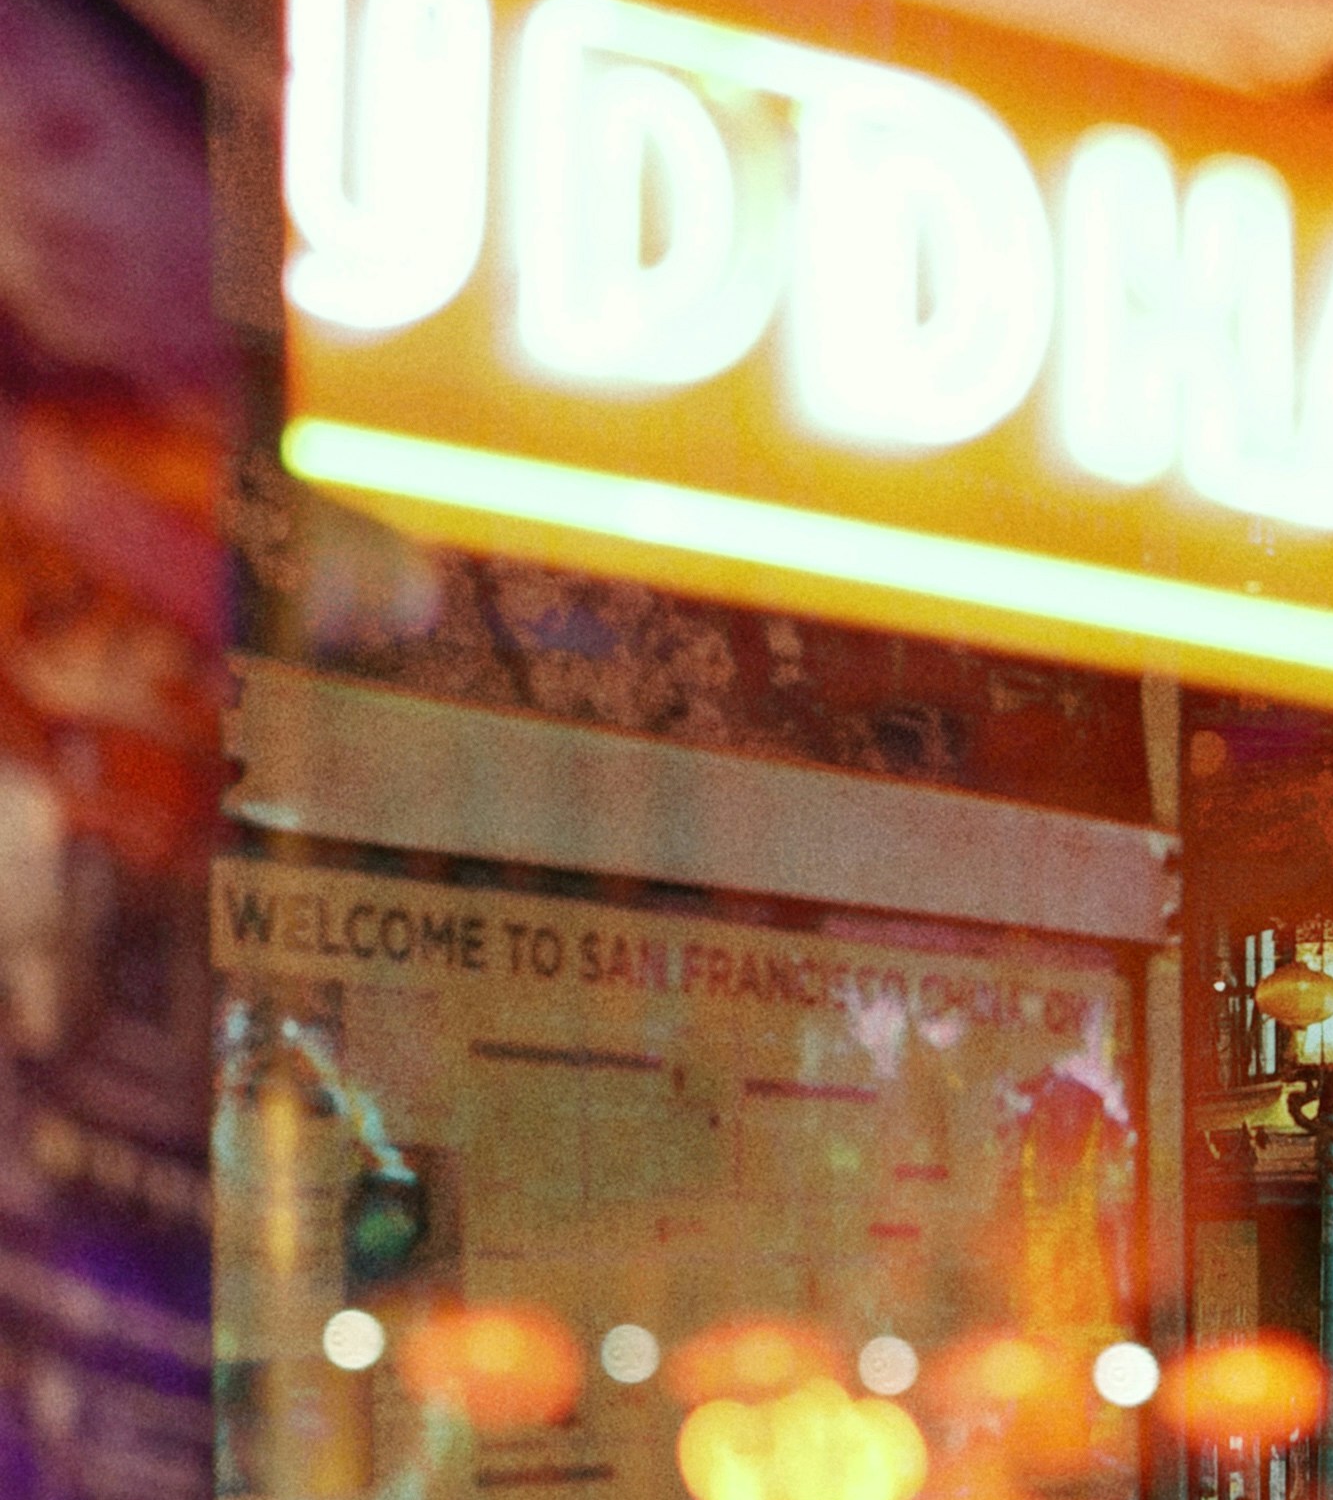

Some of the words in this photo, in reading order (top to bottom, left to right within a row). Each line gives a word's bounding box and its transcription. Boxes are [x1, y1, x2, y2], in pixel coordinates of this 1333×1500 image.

[226, 886, 487, 973] WELCOME
[503, 921, 565, 979] TO
[579, 931, 668, 993] SAN
